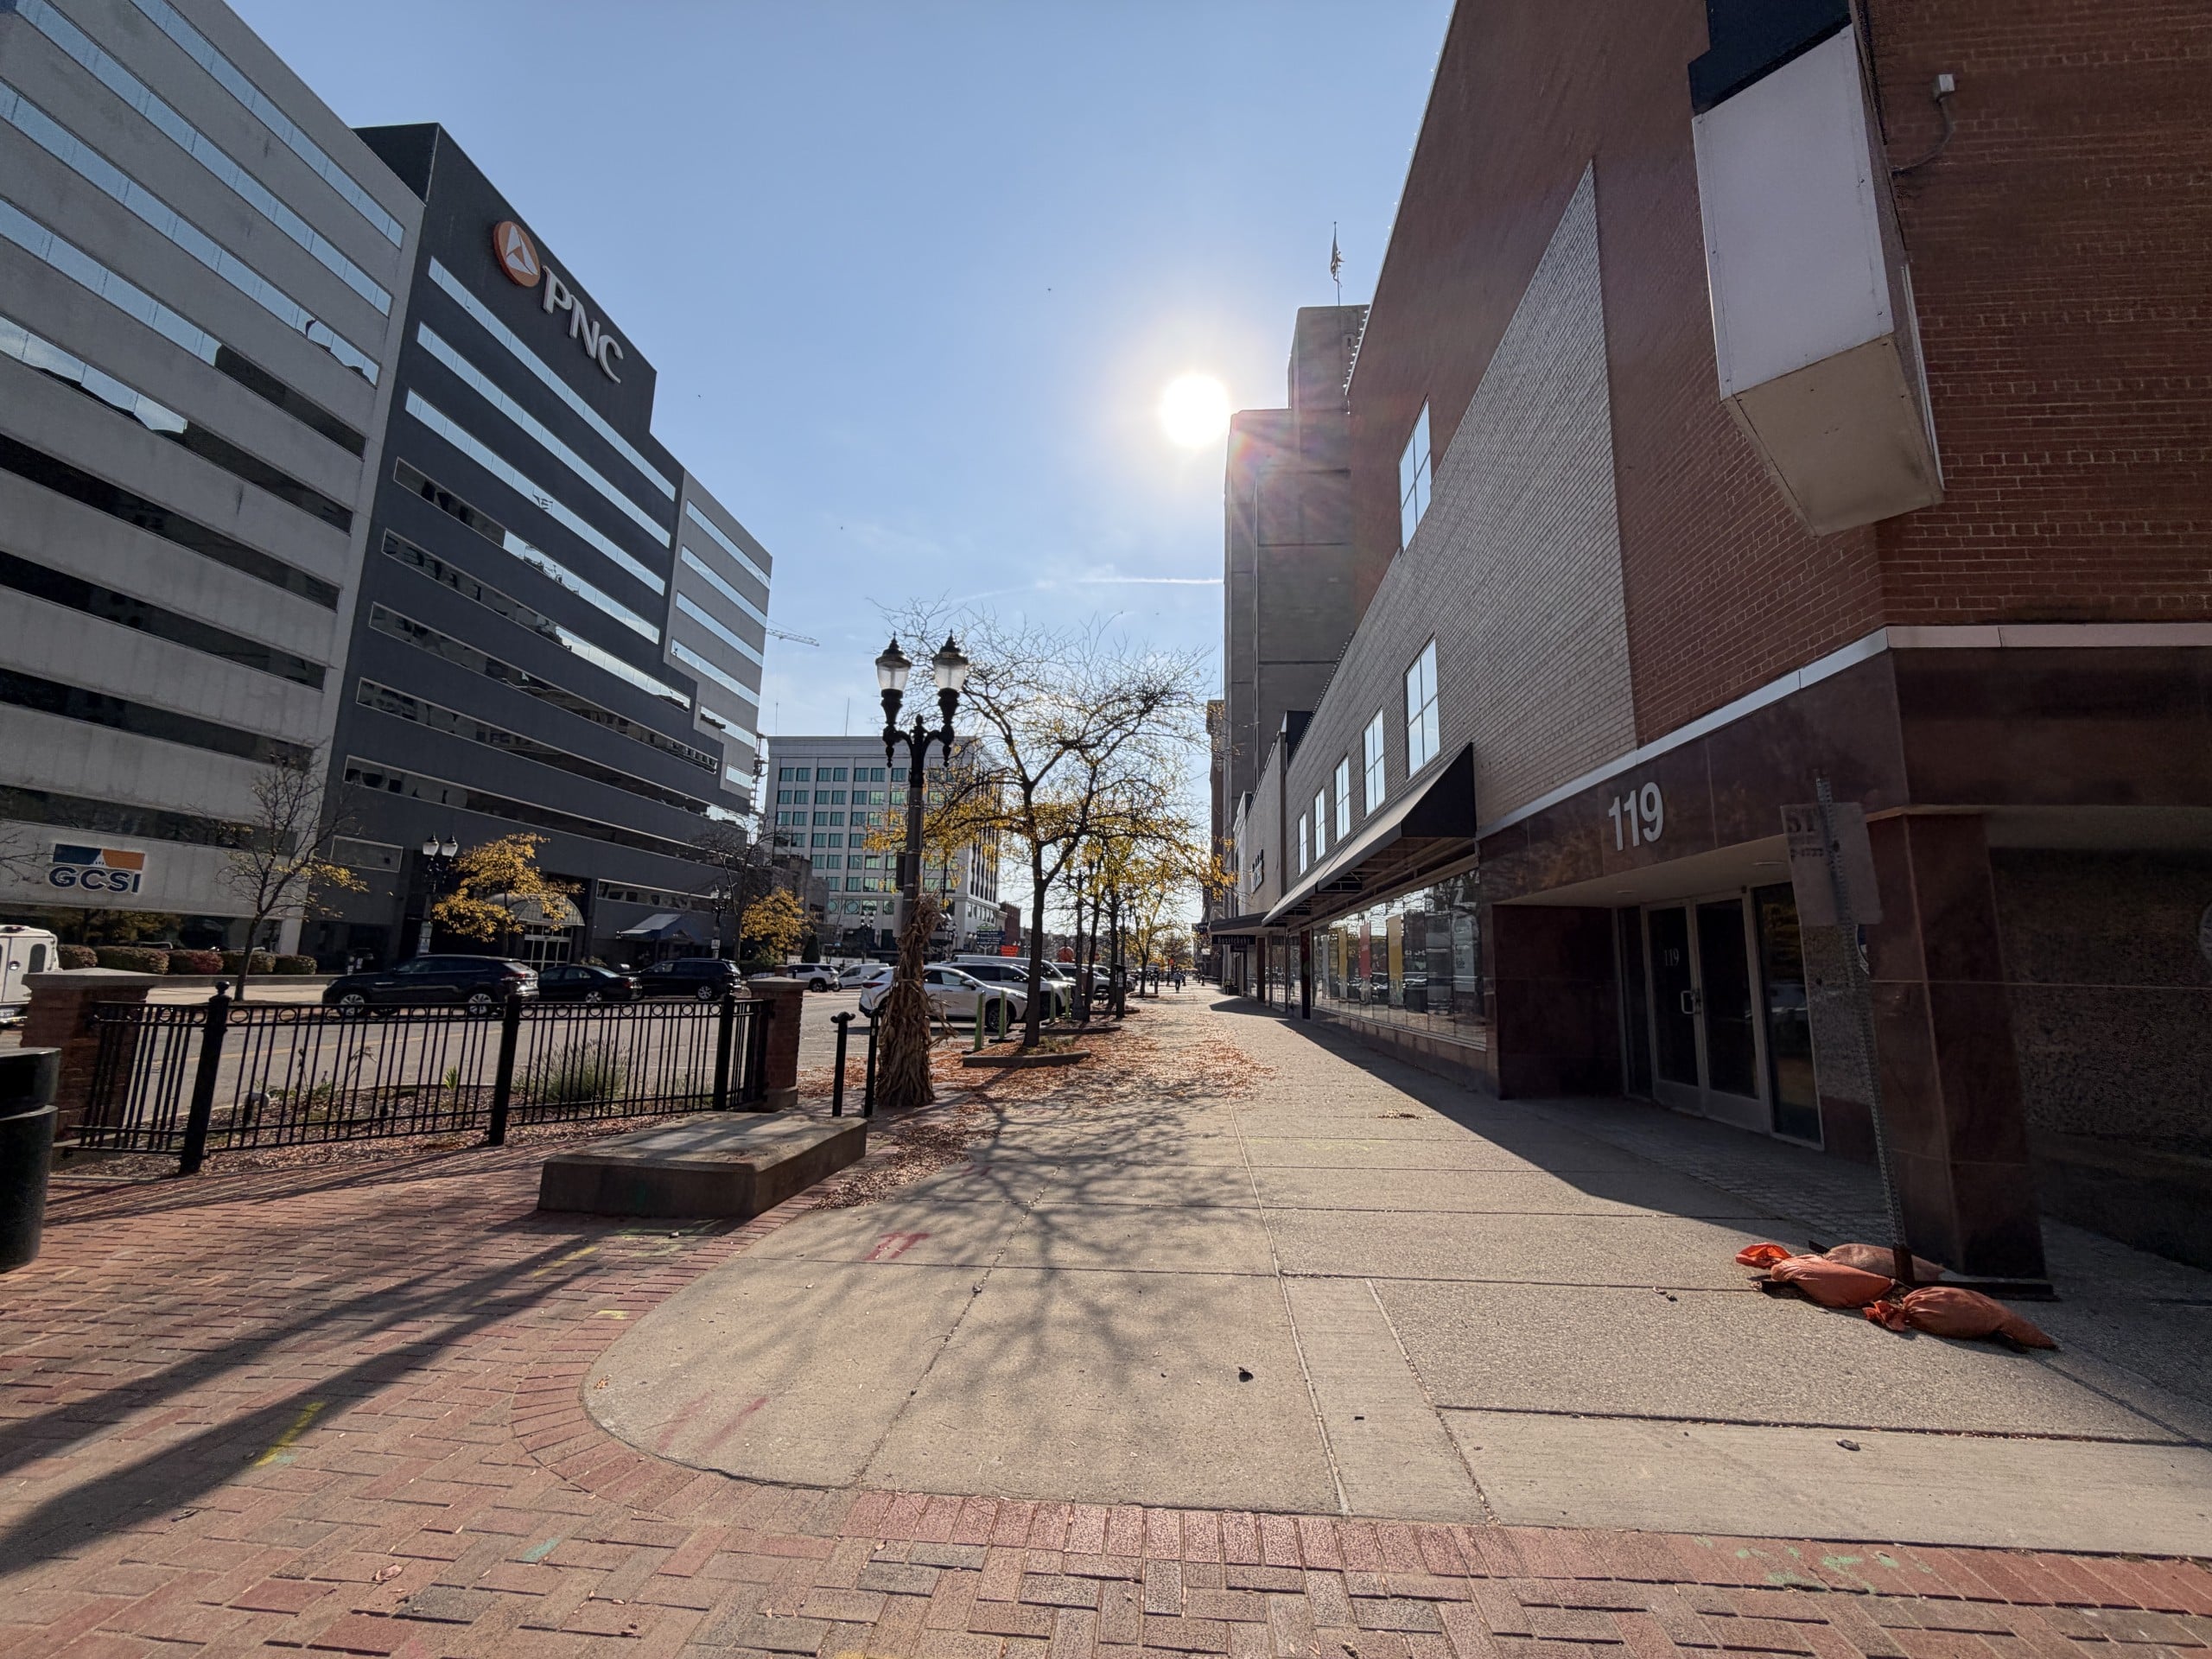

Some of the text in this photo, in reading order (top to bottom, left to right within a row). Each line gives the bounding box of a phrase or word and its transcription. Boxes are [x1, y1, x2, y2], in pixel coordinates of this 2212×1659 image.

[542, 264, 624, 384] PNC
[1608, 781, 1664, 851] 119
[48, 866, 141, 893] GCSI
[1664, 947, 1680, 966] 119
